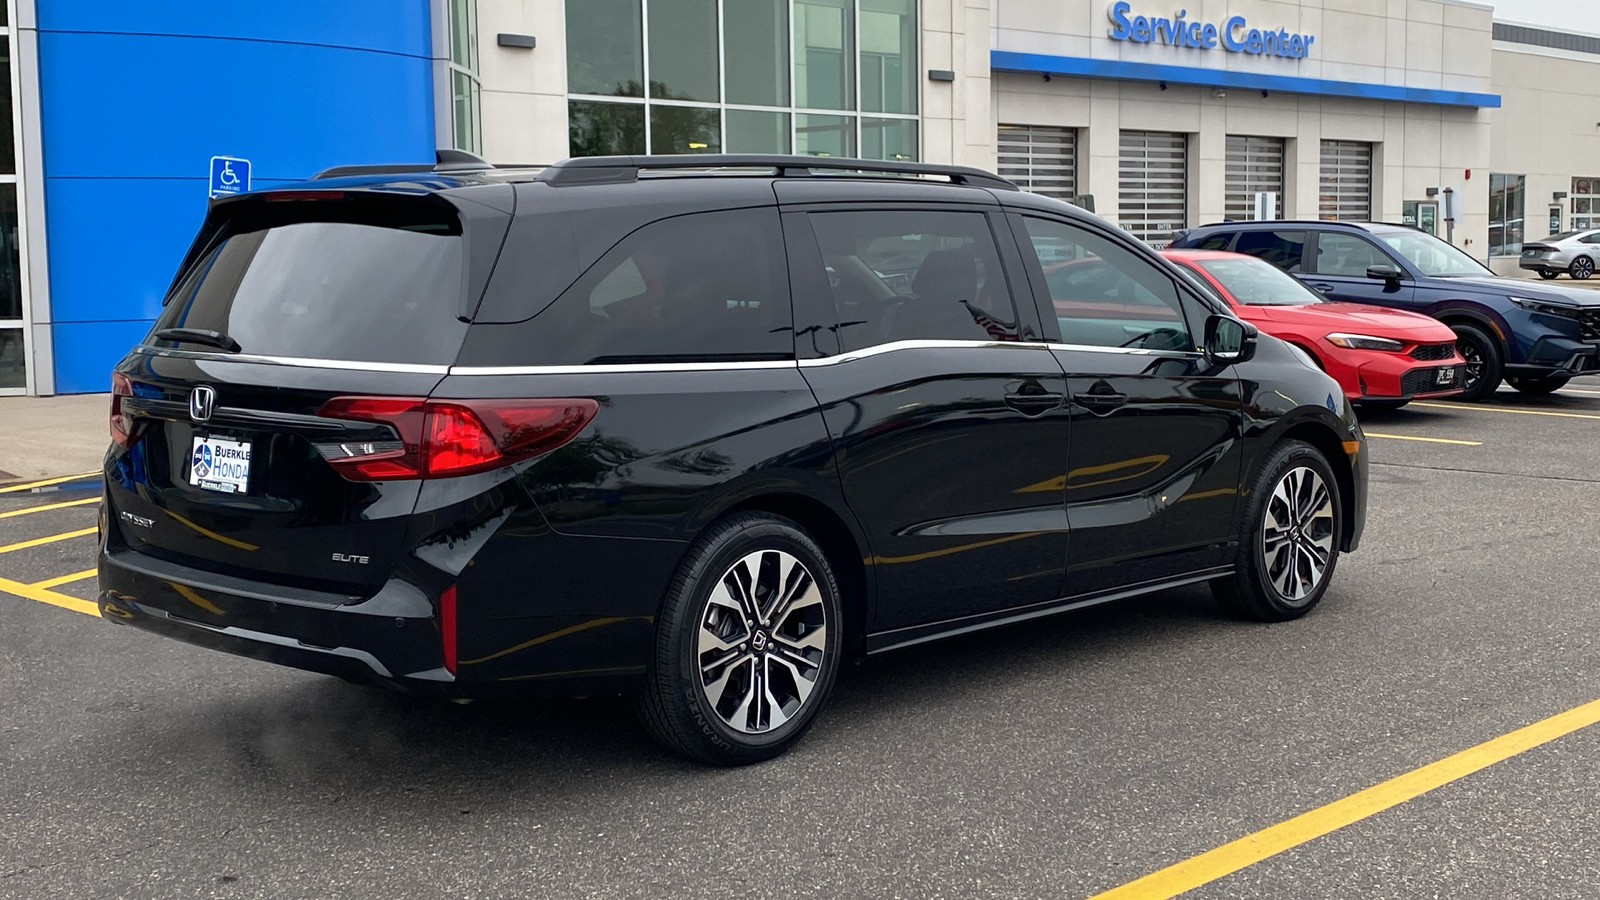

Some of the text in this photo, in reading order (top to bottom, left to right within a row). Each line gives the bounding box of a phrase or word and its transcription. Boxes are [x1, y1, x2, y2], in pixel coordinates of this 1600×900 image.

[1108, 1, 1315, 58] Service Center
[215, 445, 250, 461] BUERKLE
[213, 458, 248, 479] HONDA
[332, 552, 370, 564] ELITE
